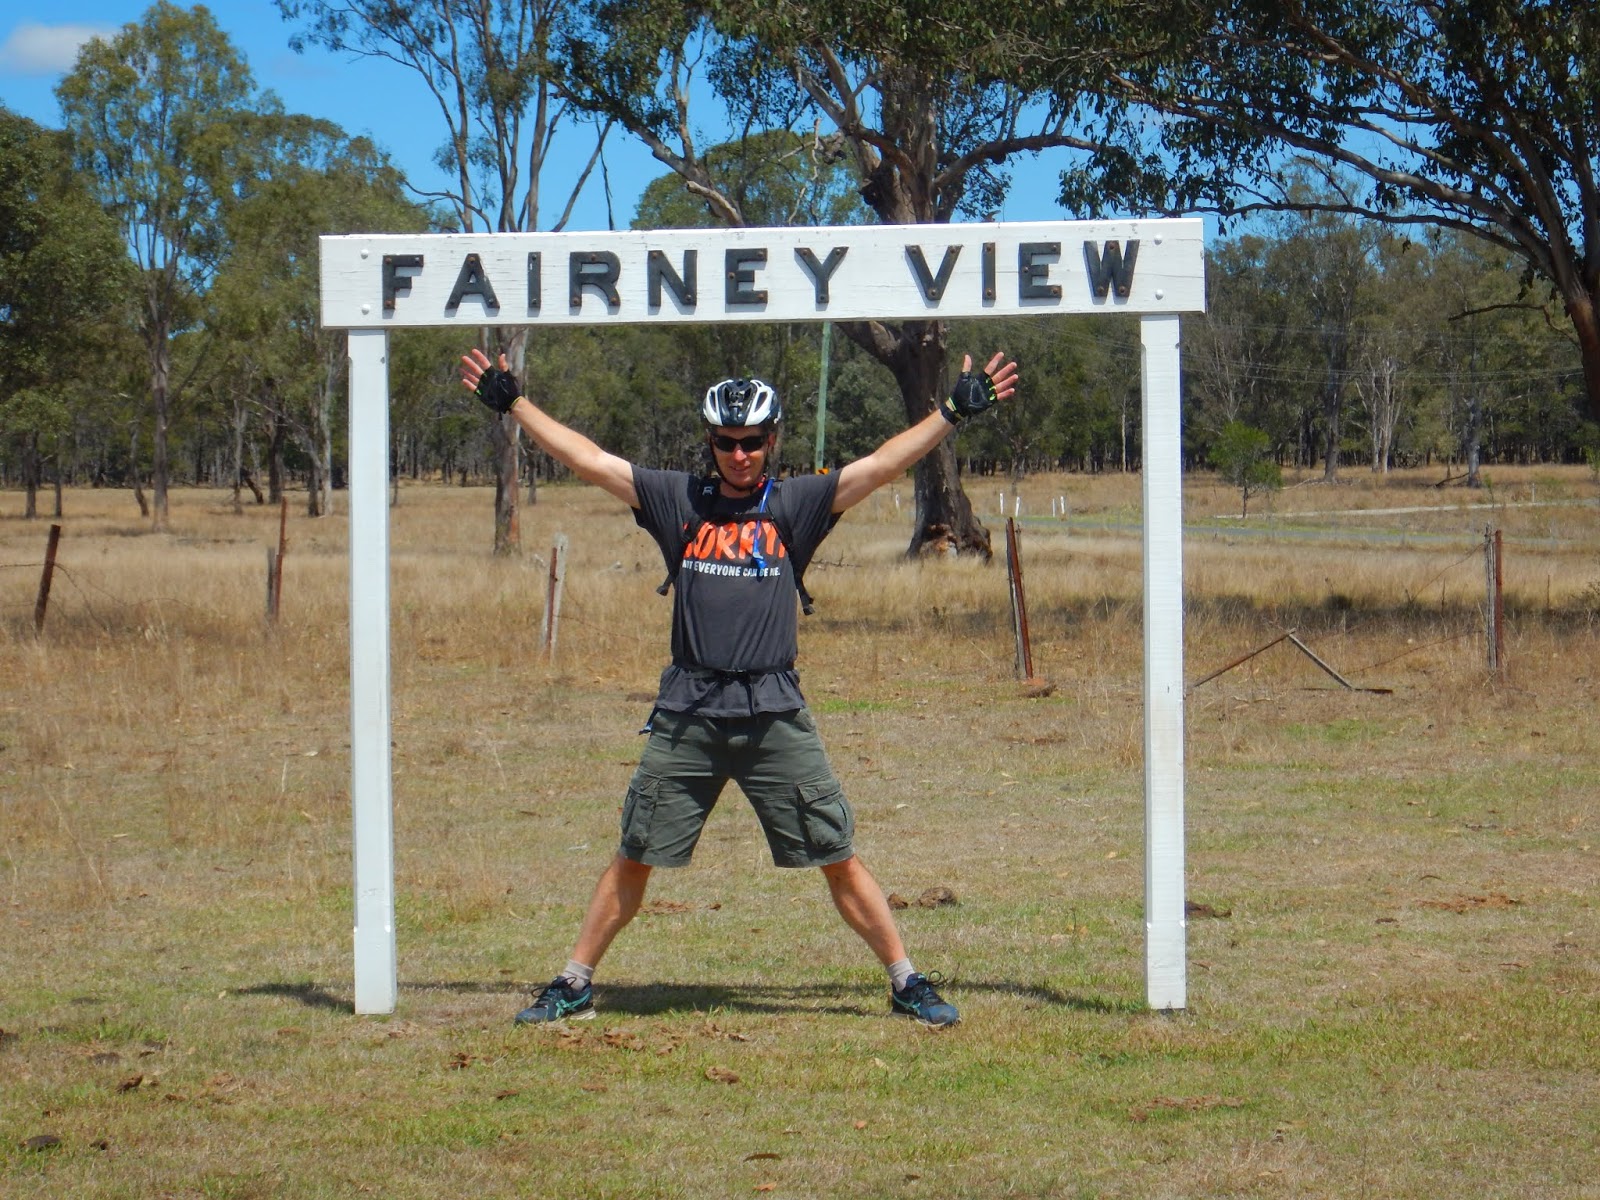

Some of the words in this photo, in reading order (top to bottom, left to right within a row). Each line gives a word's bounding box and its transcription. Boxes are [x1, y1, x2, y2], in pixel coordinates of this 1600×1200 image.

[383, 247, 848, 309] FAIRNEY
[905, 240, 1140, 301] VIEW
[693, 561, 742, 577] EVERYONE
[742, 568, 758, 577] CAN
